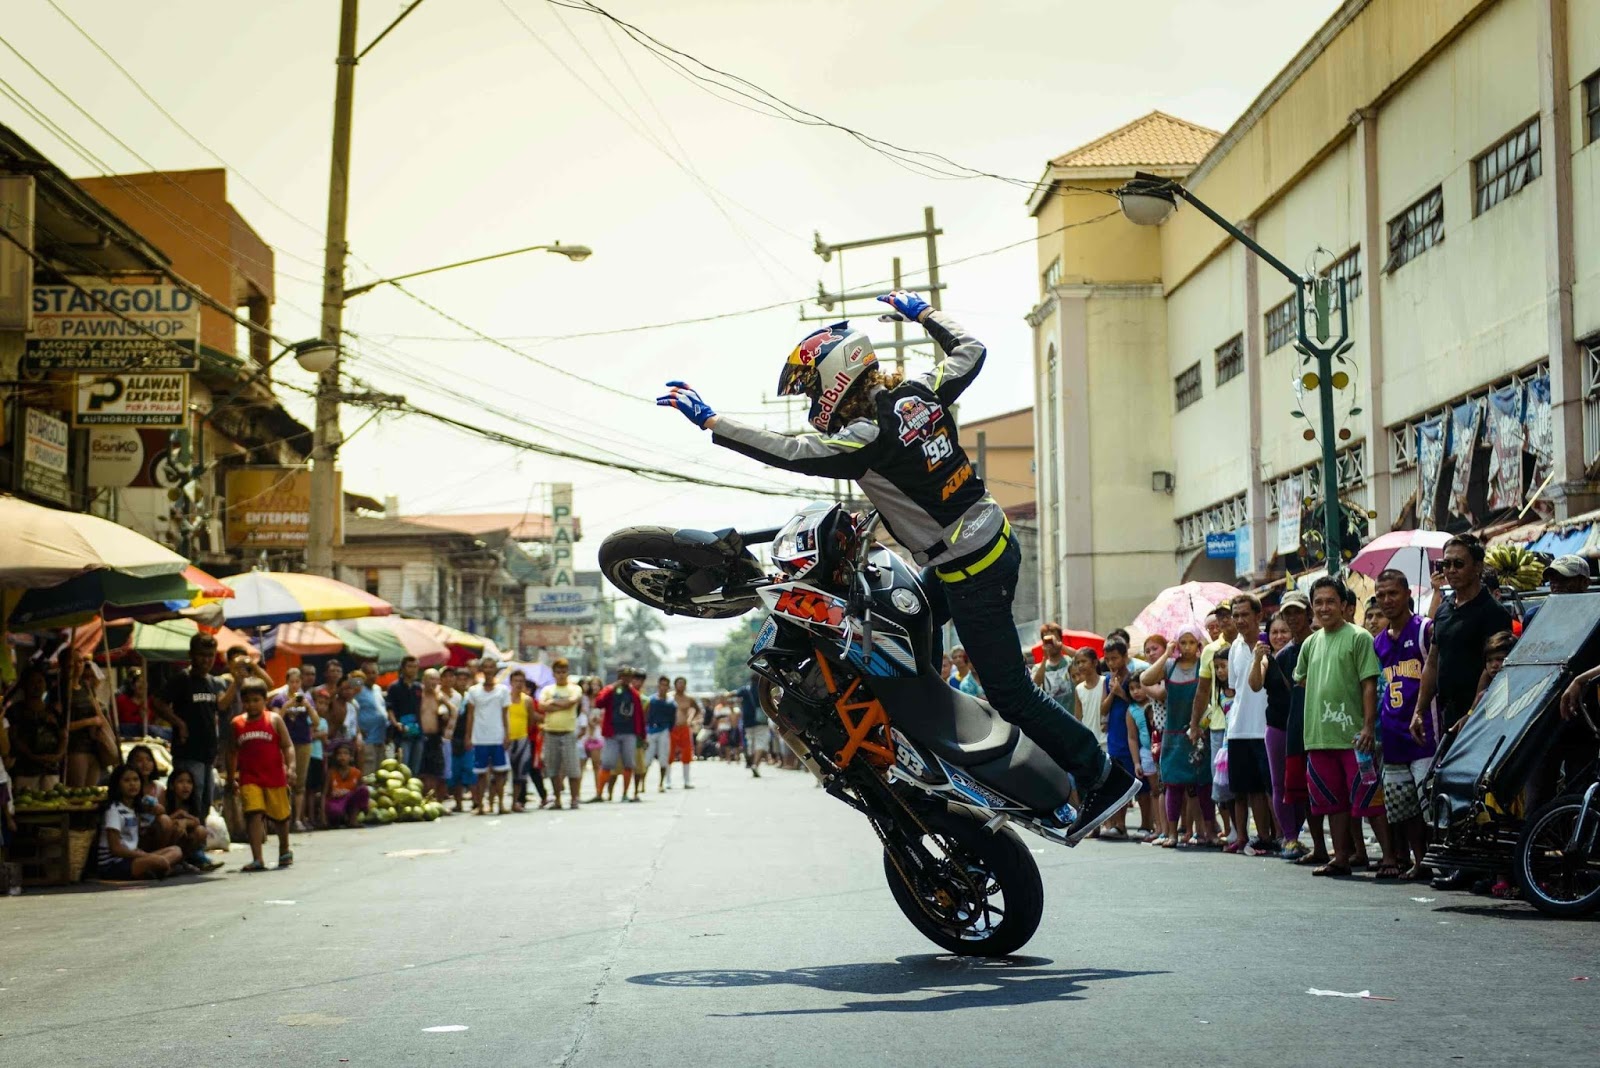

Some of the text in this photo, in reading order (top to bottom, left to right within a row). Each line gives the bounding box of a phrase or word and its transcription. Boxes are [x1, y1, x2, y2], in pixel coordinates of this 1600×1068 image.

[33, 288, 193, 312] STARGOLD
[61, 320, 184, 336] PAWNSHOP
[29, 350, 85, 358] MONEY
[40, 340, 97, 349] MONEY
[851, 347, 862, 361] BELL
[126, 378, 181, 389] ALAWAN
[126, 391, 181, 402] EXPRESS
[813, 371, 852, 430] Red Bull
[83, 415, 177, 424] AUTHORIZED AGENT
[926, 434, 950, 464] 93
[942, 463, 974, 501] KTM
[554, 506, 571, 586] PAPA
[774, 586, 845, 627] KTM
[1390, 681, 1403, 708] 5
[896, 744, 924, 776] 93
